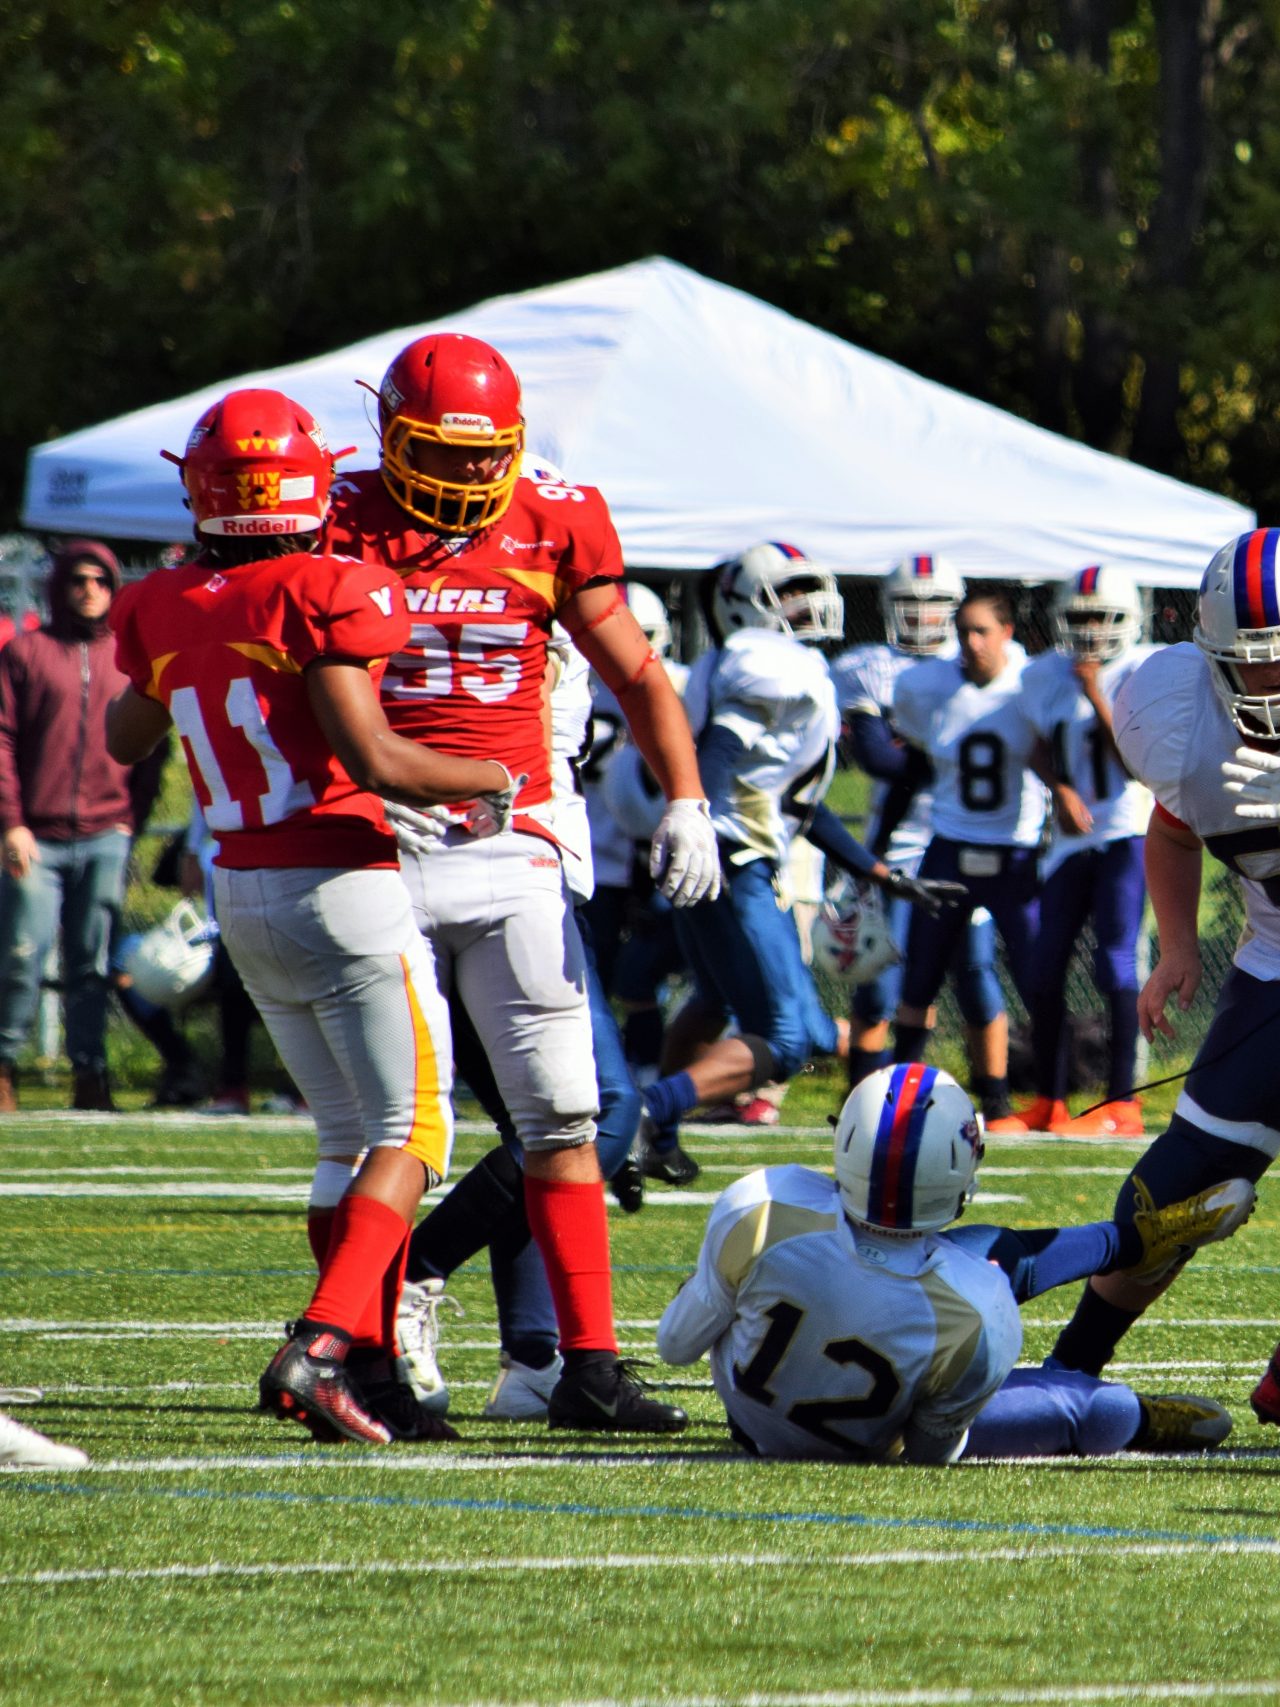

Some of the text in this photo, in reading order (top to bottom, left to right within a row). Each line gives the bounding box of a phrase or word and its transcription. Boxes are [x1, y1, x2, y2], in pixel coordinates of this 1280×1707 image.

[222, 519, 298, 534] Riddell
[368, 586, 393, 617] V
[169, 676, 317, 832] 11
[959, 731, 1007, 812] 8
[732, 1301, 901, 1453] 12
